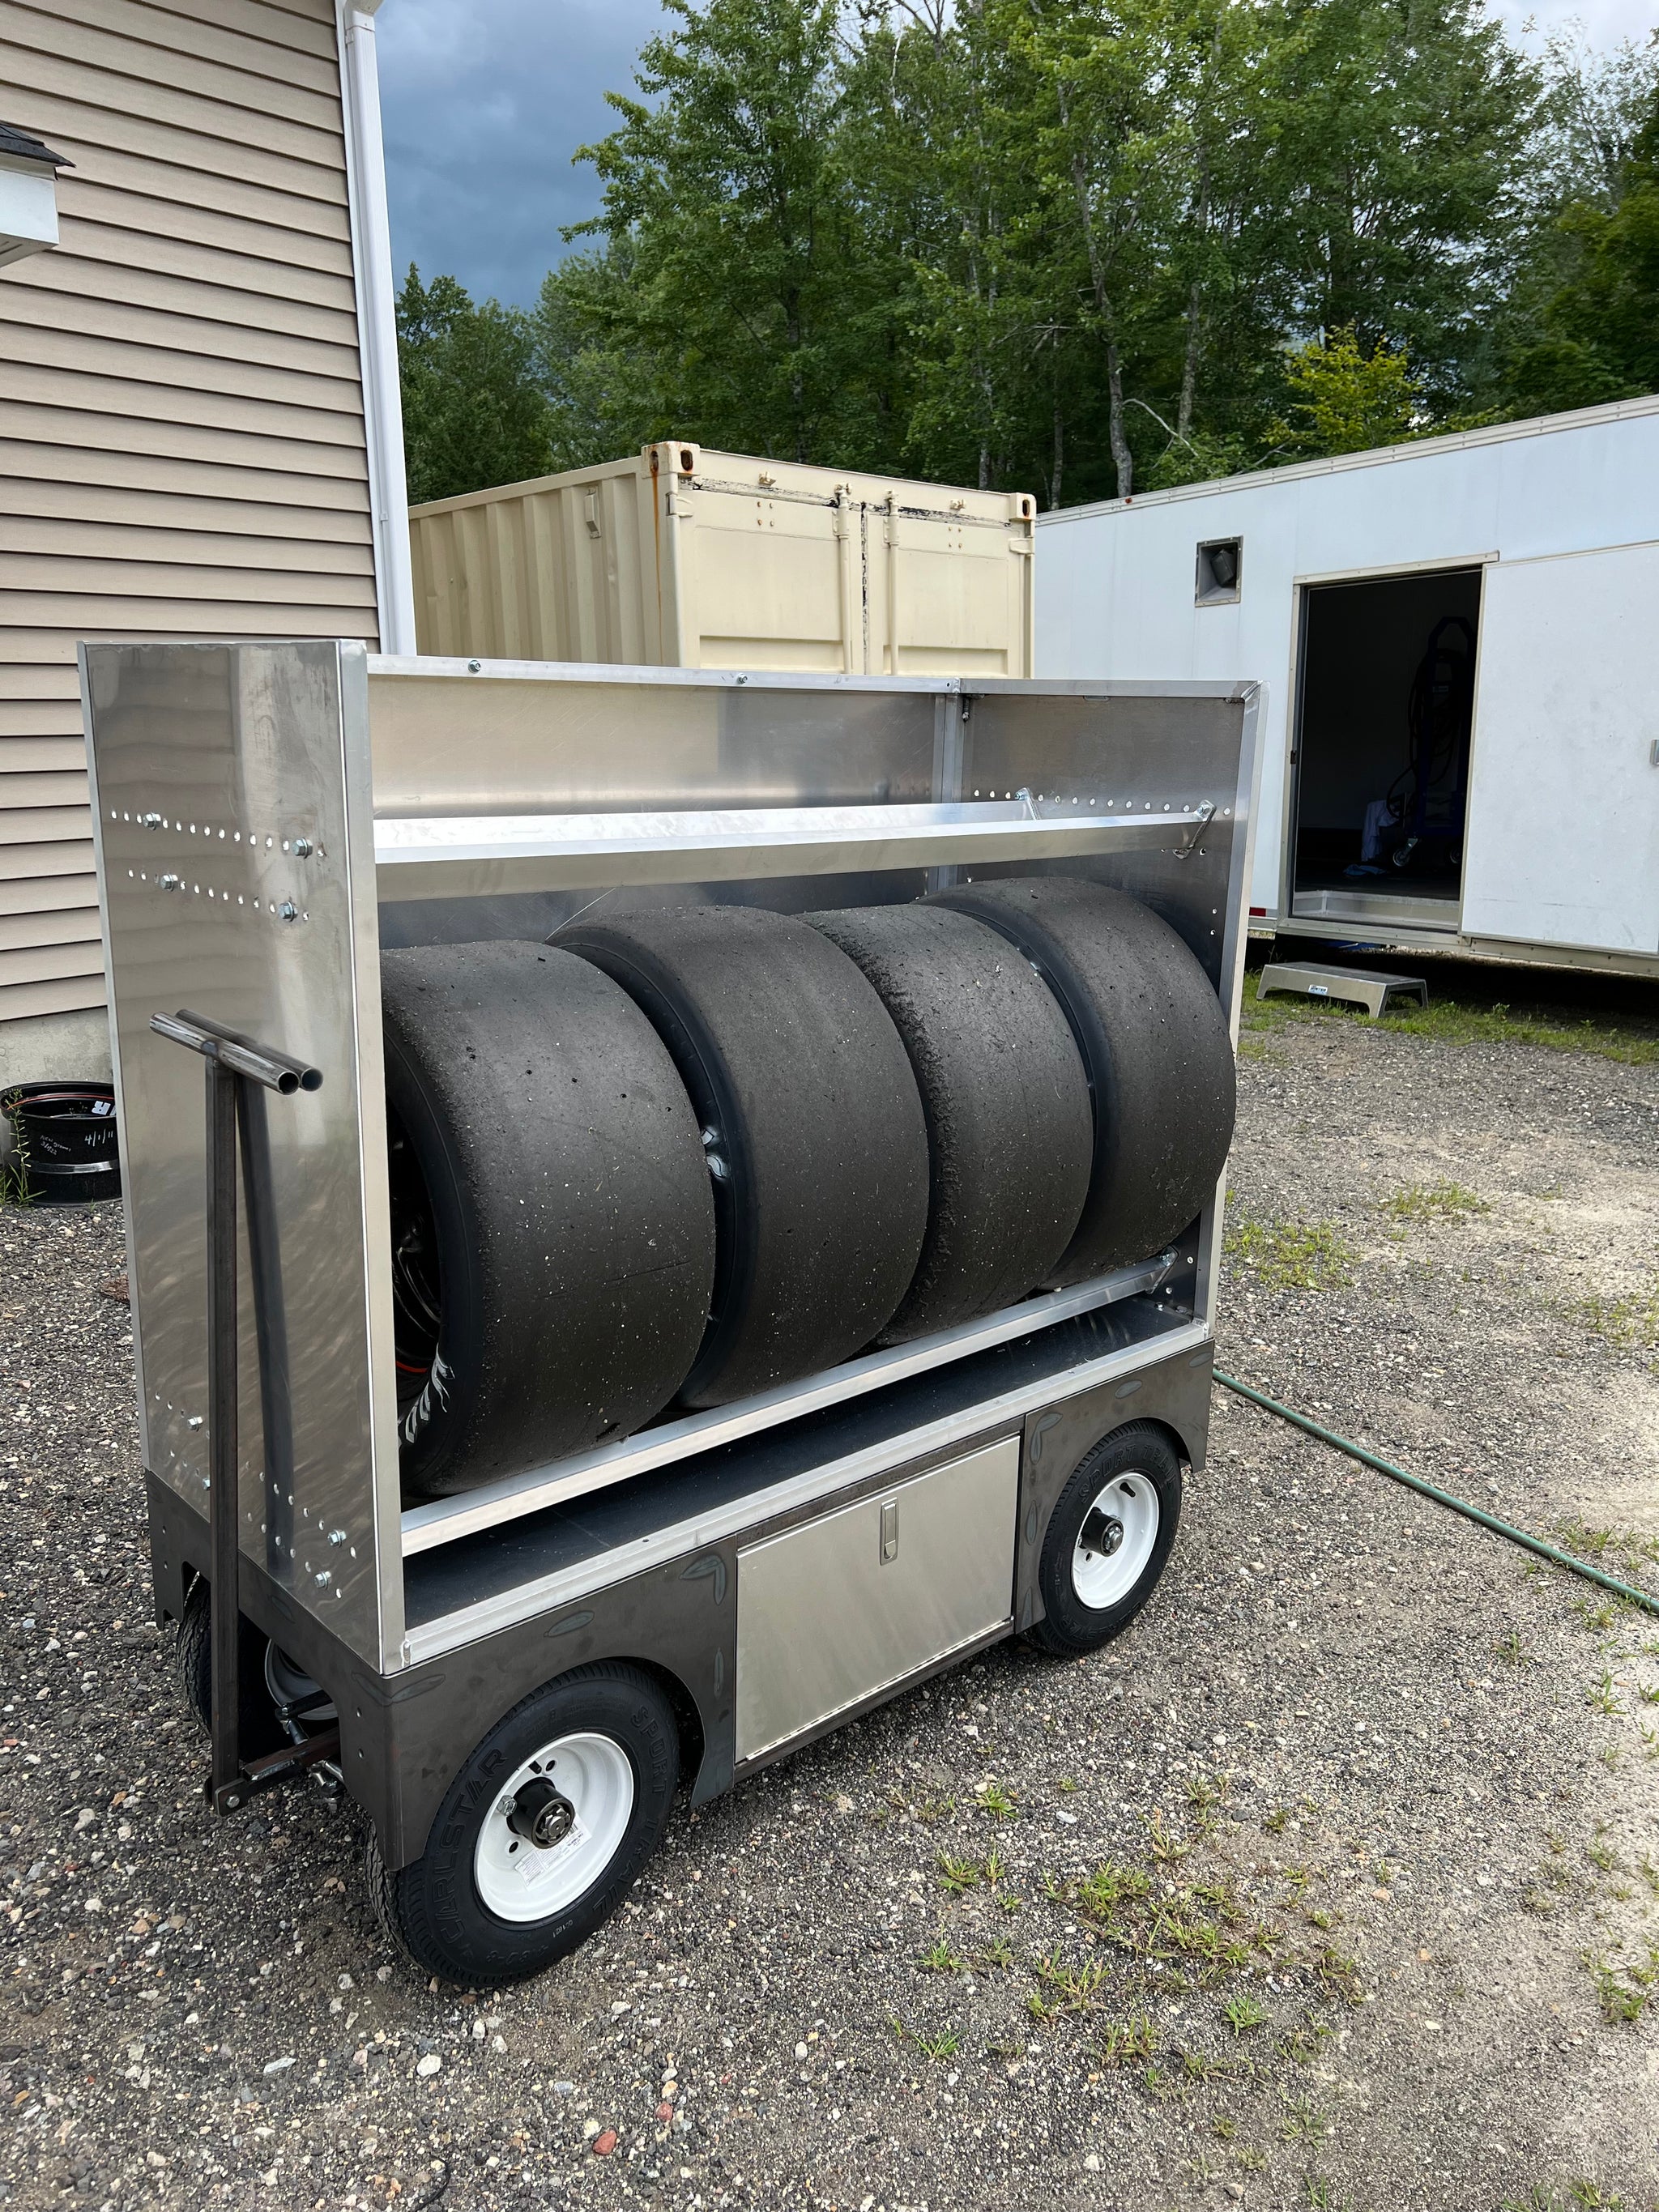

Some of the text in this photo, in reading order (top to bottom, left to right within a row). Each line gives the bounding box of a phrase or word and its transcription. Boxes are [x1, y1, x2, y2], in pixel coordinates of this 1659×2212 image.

[1078, 1443, 1137, 1504] SPORT
[432, 1747, 510, 1945] CARLSTAR
[592, 1706, 669, 1916] SPORT TRAIL
